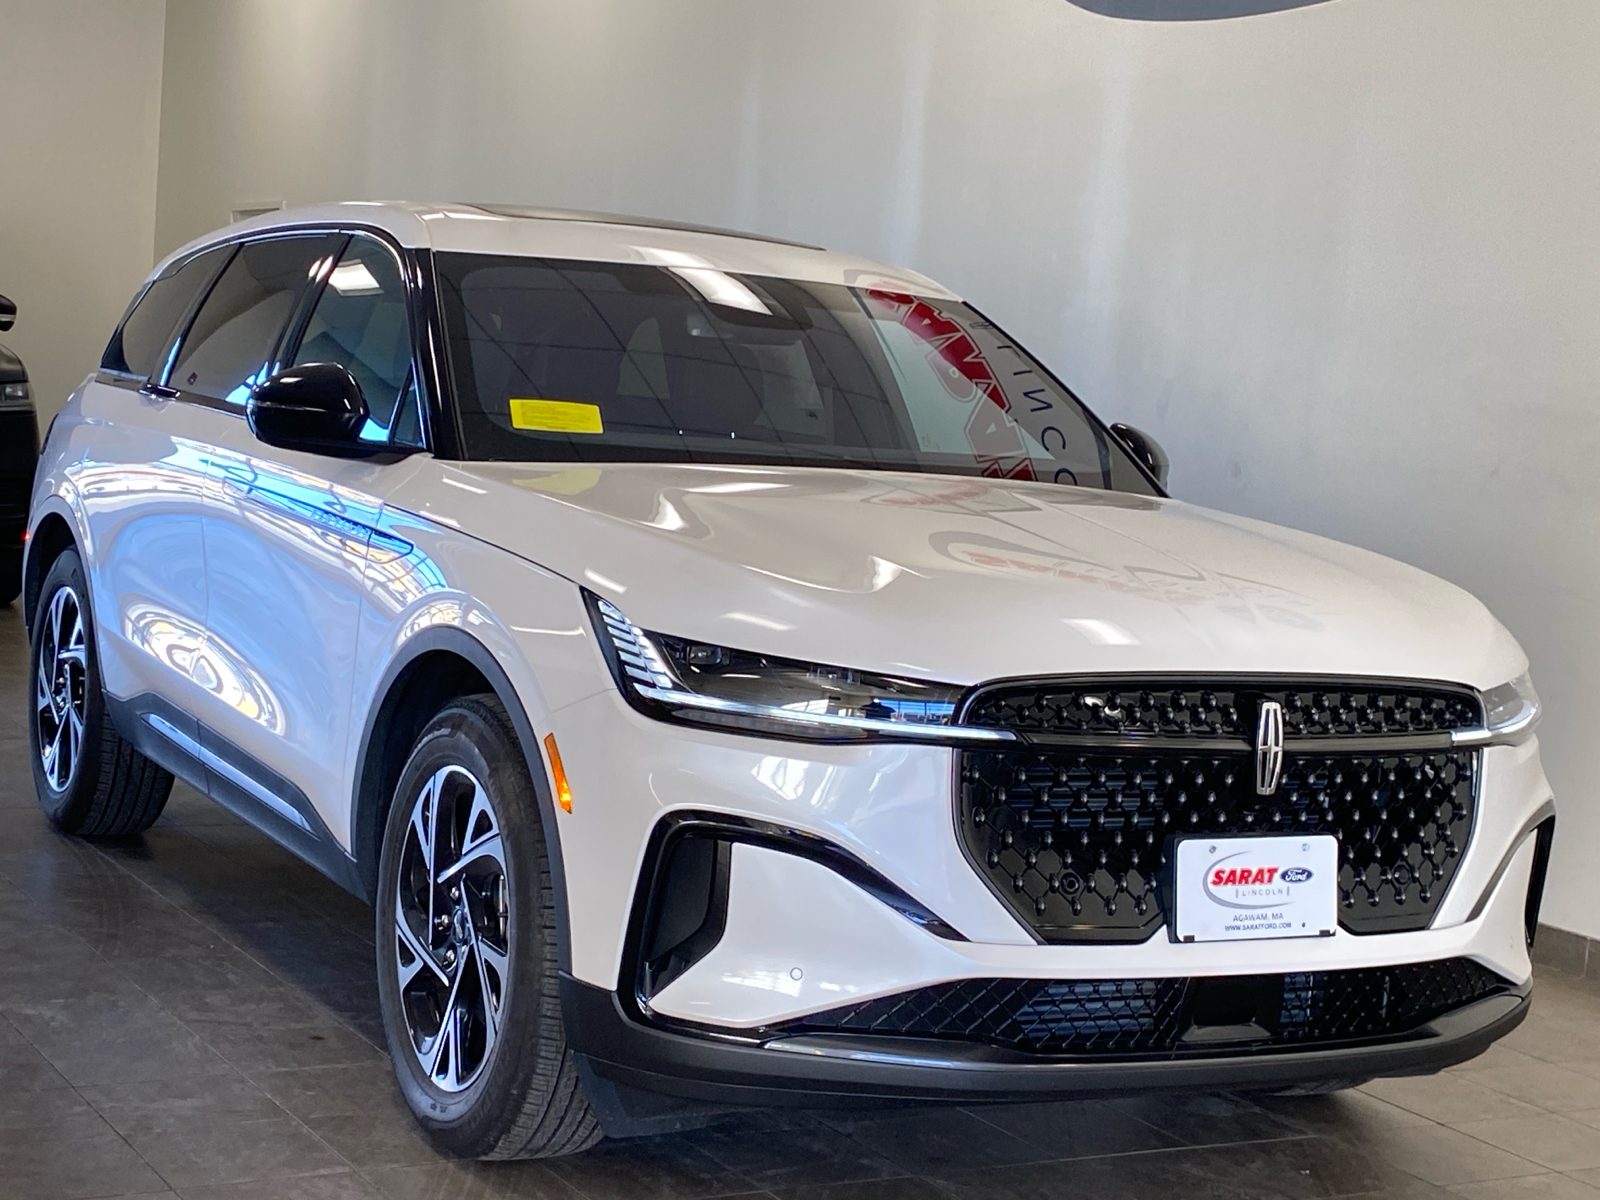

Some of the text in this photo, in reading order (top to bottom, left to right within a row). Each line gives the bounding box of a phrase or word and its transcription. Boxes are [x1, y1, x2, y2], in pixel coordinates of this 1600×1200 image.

[1211, 867, 1309, 886] SARAT Ford
[1241, 888, 1284, 897] LINCOLN
[1232, 912, 1284, 922] AGAWAM, MA
[1224, 922, 1292, 931] WWW.SARATFORD.COM
